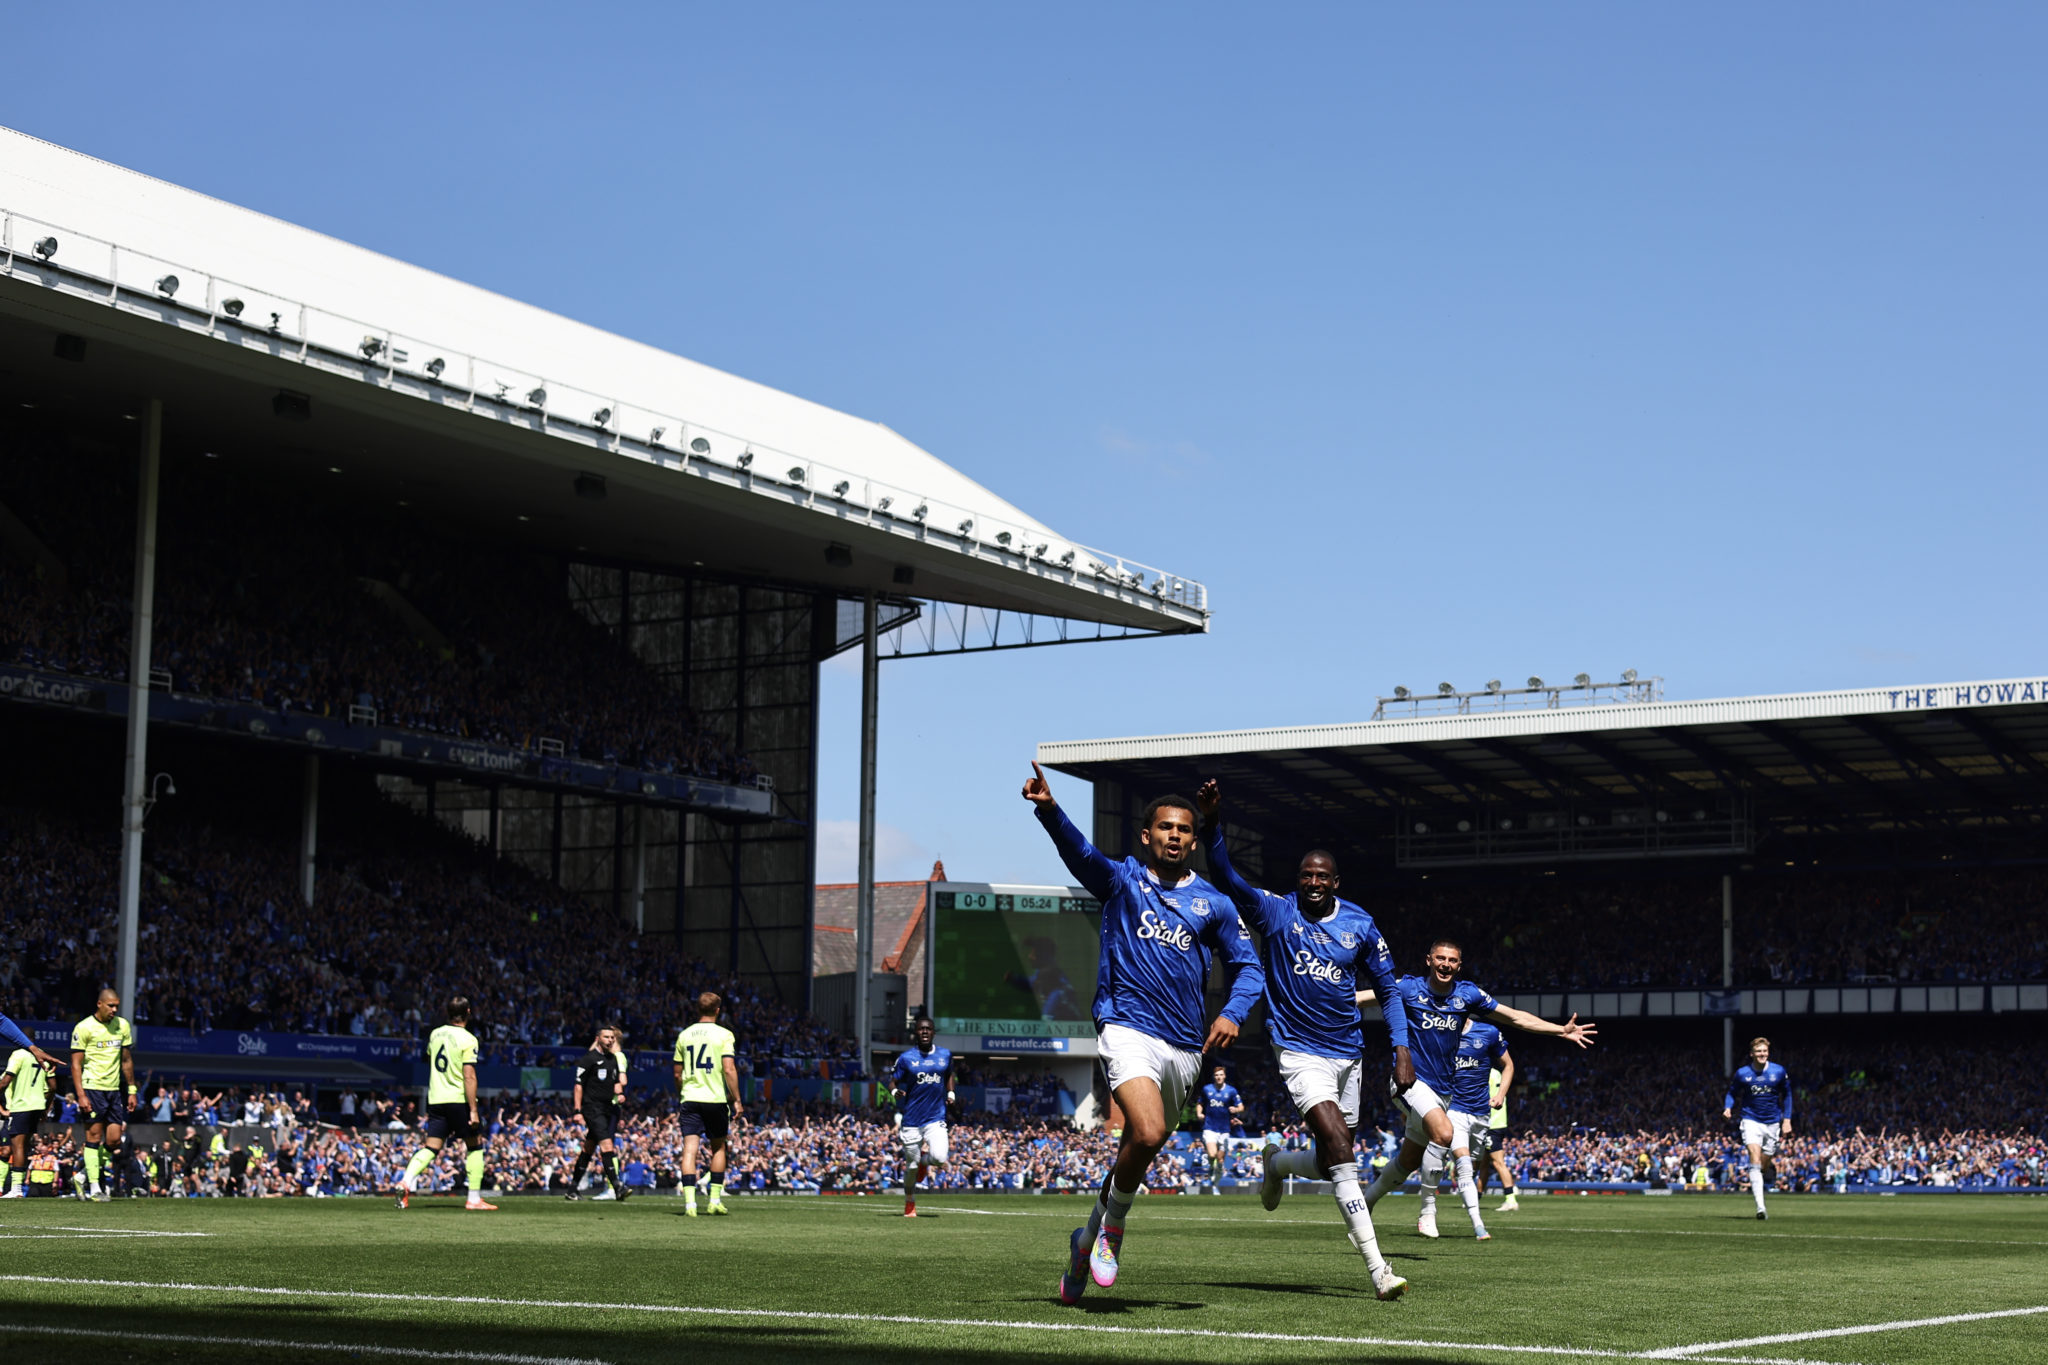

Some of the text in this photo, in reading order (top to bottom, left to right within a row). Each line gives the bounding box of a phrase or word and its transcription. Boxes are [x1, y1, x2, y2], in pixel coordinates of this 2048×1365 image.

[1888, 688, 1938, 709] THE
[963, 894, 987, 908] 0-0
[1021, 896, 1052, 909] 05:24
[1136, 910, 1192, 951] Stake
[1293, 950, 1342, 983] Stake
[955, 1020, 982, 1033] THE
[988, 1021, 1017, 1034] END
[1021, 1023, 1041, 1035] OF
[1046, 1024, 1063, 1036] AN
[1421, 1012, 1458, 1031] Stake
[987, 1036, 1064, 1049] evertonfc.com
[435, 1043, 448, 1073] 6
[686, 1043, 714, 1075] 14
[31, 1062, 42, 1087] 7
[916, 1071, 942, 1085] Stake
[1346, 1198, 1366, 1215] EFC
